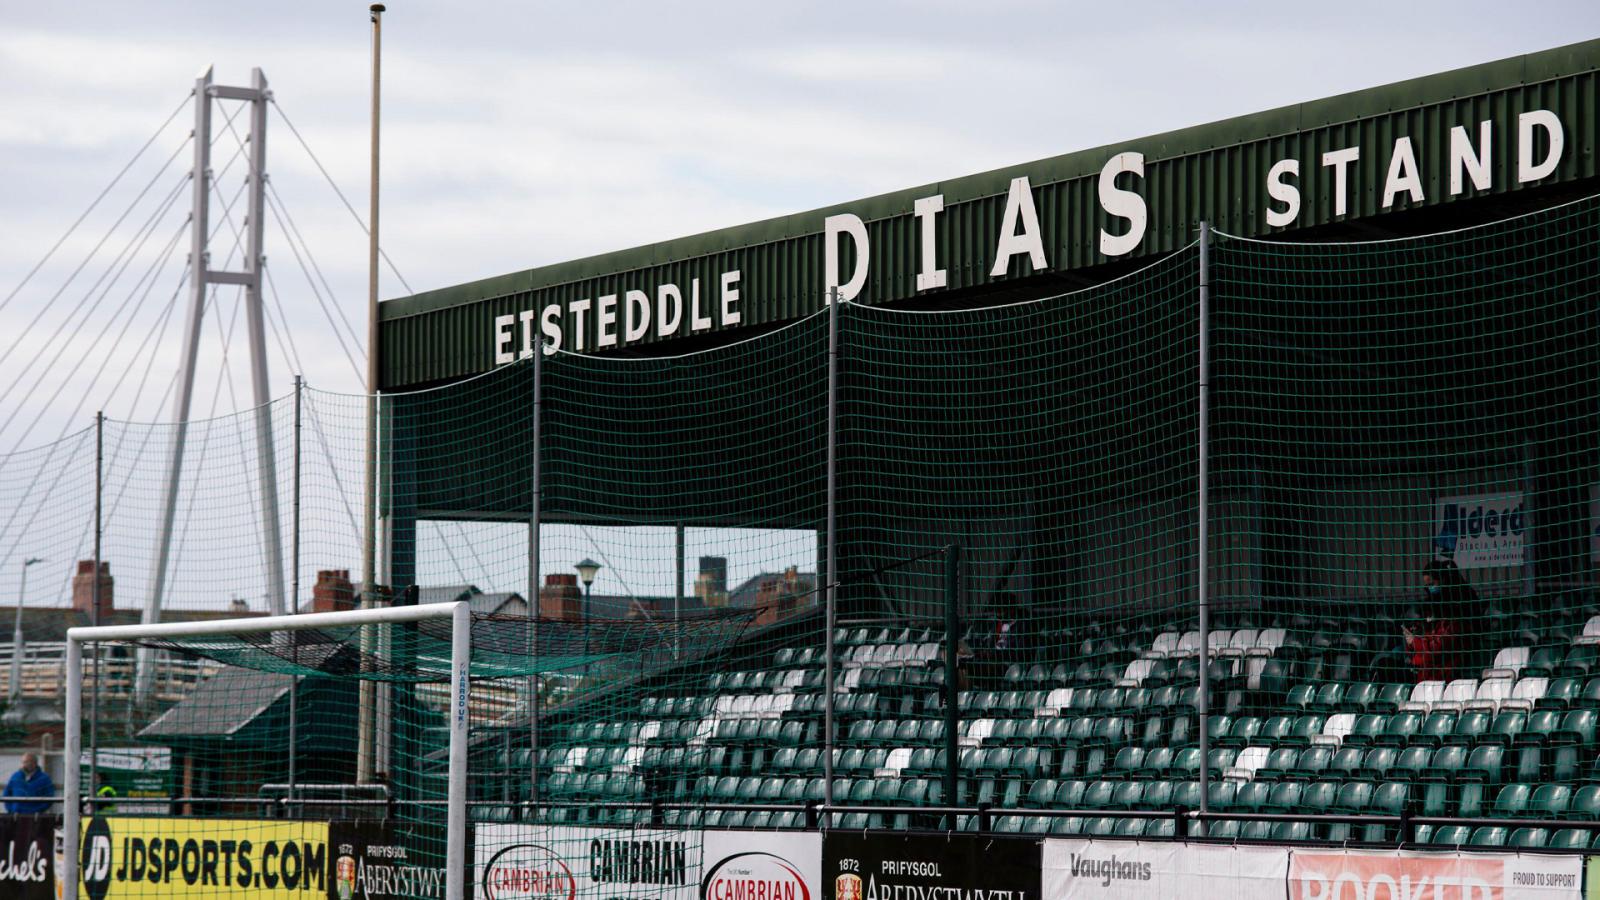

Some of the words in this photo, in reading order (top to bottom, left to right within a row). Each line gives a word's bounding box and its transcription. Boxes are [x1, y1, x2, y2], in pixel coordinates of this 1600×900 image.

[496, 270, 740, 365] EISTEDDLE
[825, 152, 1147, 305] DIAS
[1267, 110, 1564, 226] STAND
[85, 835, 110, 882] JD
[117, 837, 325, 891] JDSPORTS.COM
[366, 845, 408, 858] PRIFYSGOL
[590, 838, 686, 886] CAMBRIAN
[839, 858, 859, 872] 1872
[354, 855, 446, 900] ABERYSTWY
[494, 868, 564, 895] CAMBRIAN
[882, 860, 941, 877] PRIFYSGOL
[1070, 853, 1152, 887] Vaughans
[1513, 872, 1535, 886] PROUD
[1536, 873, 1545, 886] TO
[1546, 873, 1576, 887] SUPPORT
[715, 878, 795, 900] CAMBRIAN
